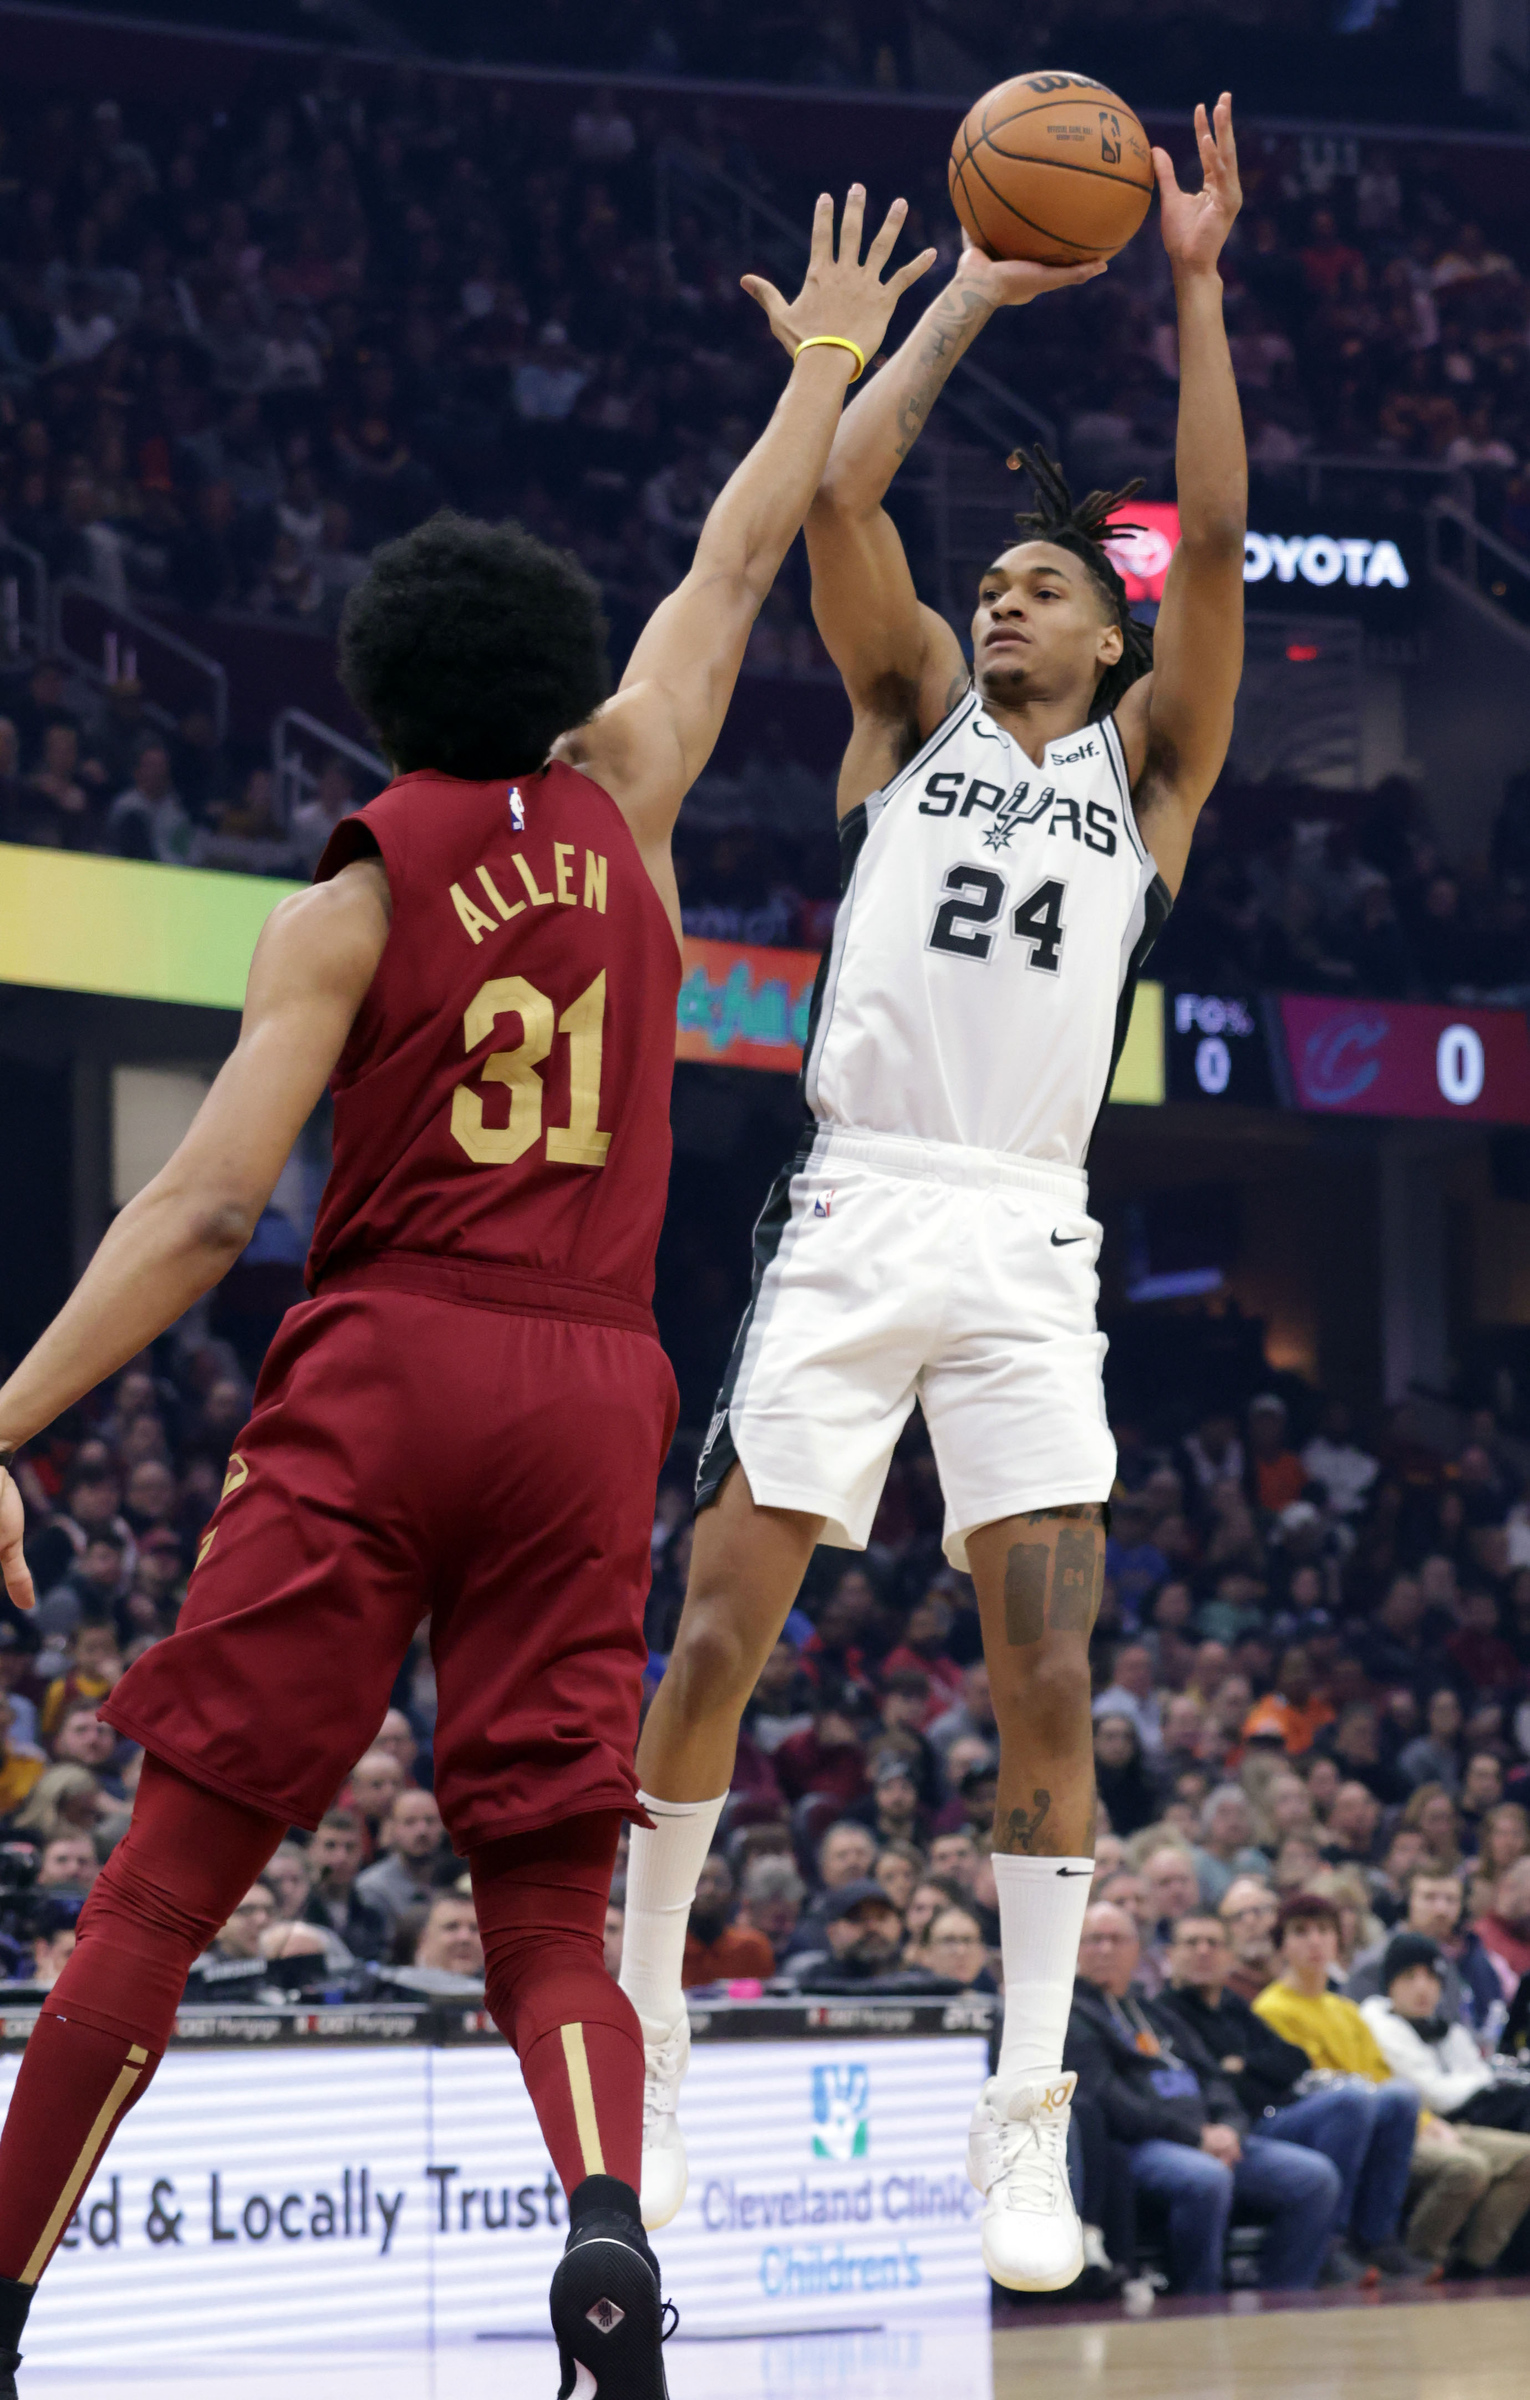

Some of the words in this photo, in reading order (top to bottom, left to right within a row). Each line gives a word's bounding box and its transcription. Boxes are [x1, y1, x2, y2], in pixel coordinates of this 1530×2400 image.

[1244, 531, 1409, 589] OYOTA
[918, 772, 1119, 858] SPURS
[449, 841, 608, 946] ALLEN
[924, 861, 1069, 978] 24
[450, 967, 613, 1167] 31
[1195, 1036, 1231, 1095] 0
[1436, 1022, 1485, 1106] 0
[61, 2175, 121, 2248] ed
[146, 2178, 182, 2246] &
[209, 2166, 404, 2254] Locally
[427, 2165, 566, 2233] Trust
[702, 2177, 873, 2232] Cleveland
